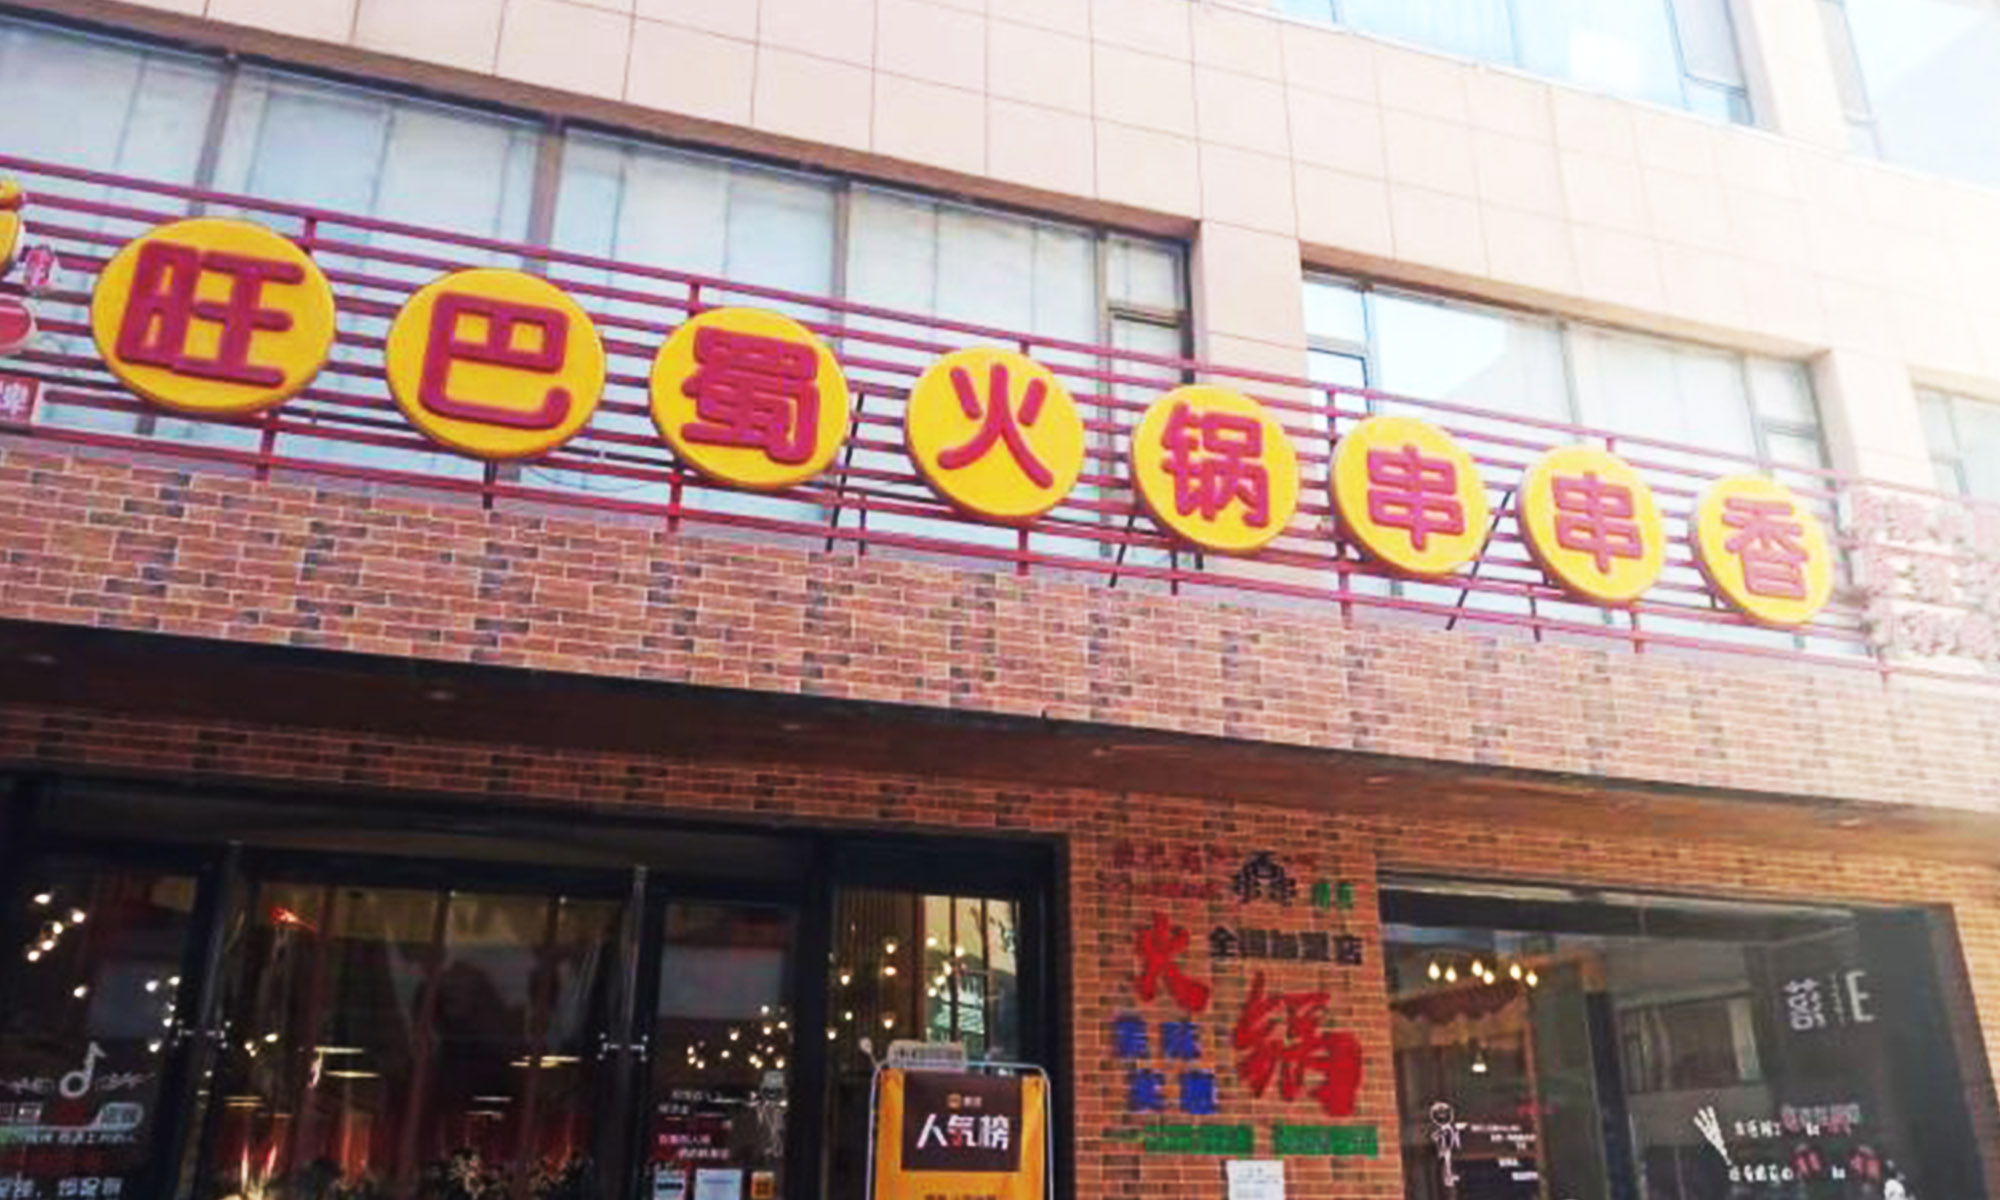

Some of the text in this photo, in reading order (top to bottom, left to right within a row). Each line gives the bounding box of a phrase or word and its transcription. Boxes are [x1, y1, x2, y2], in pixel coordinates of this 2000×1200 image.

[114, 240, 1809, 601] 旺巴蜀火锅串串香
[916, 1113, 1010, 1150] 人气榜
